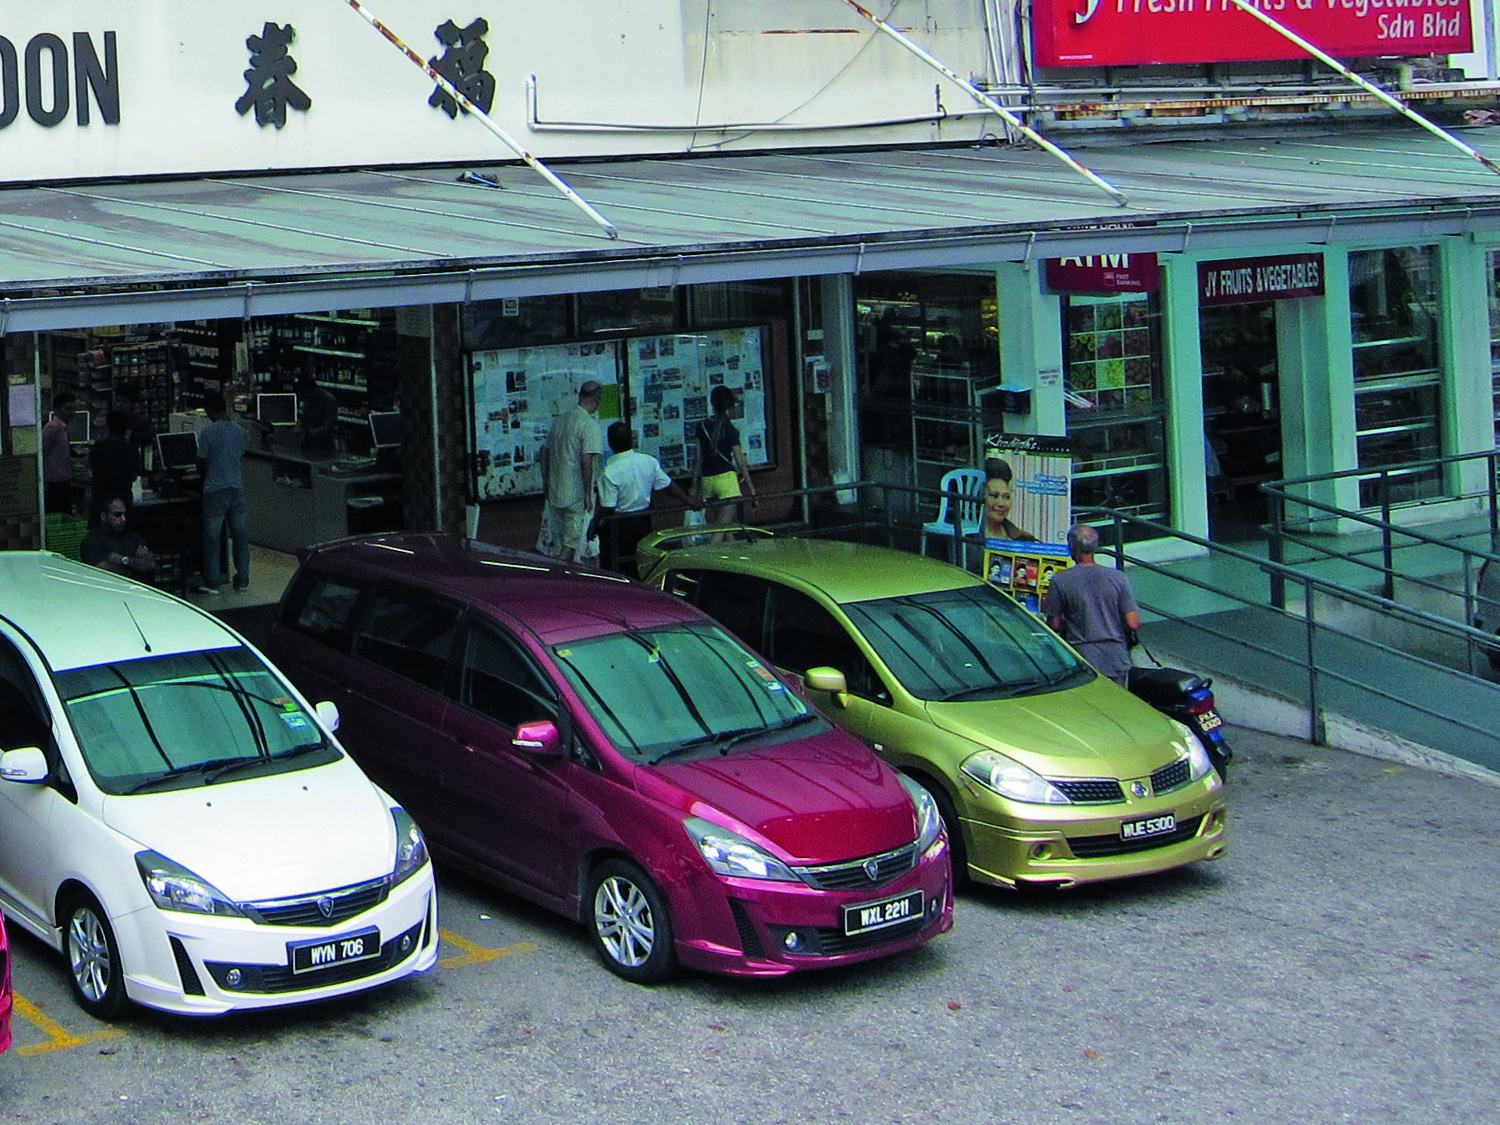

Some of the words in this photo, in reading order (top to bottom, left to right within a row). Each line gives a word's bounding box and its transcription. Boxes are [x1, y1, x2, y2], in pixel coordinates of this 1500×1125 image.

[1377, 13, 1414, 39] Sdn
[1423, 12, 1460, 37] Bhd
[1205, 271, 1217, 297] JY
[1220, 268, 1252, 295] FRUITS
[1147, 815, 1175, 832] 5300
[861, 905, 884, 926] WXL
[885, 899, 910, 921] 2211
[311, 944, 336, 965] WYN
[341, 939, 364, 958] 706
